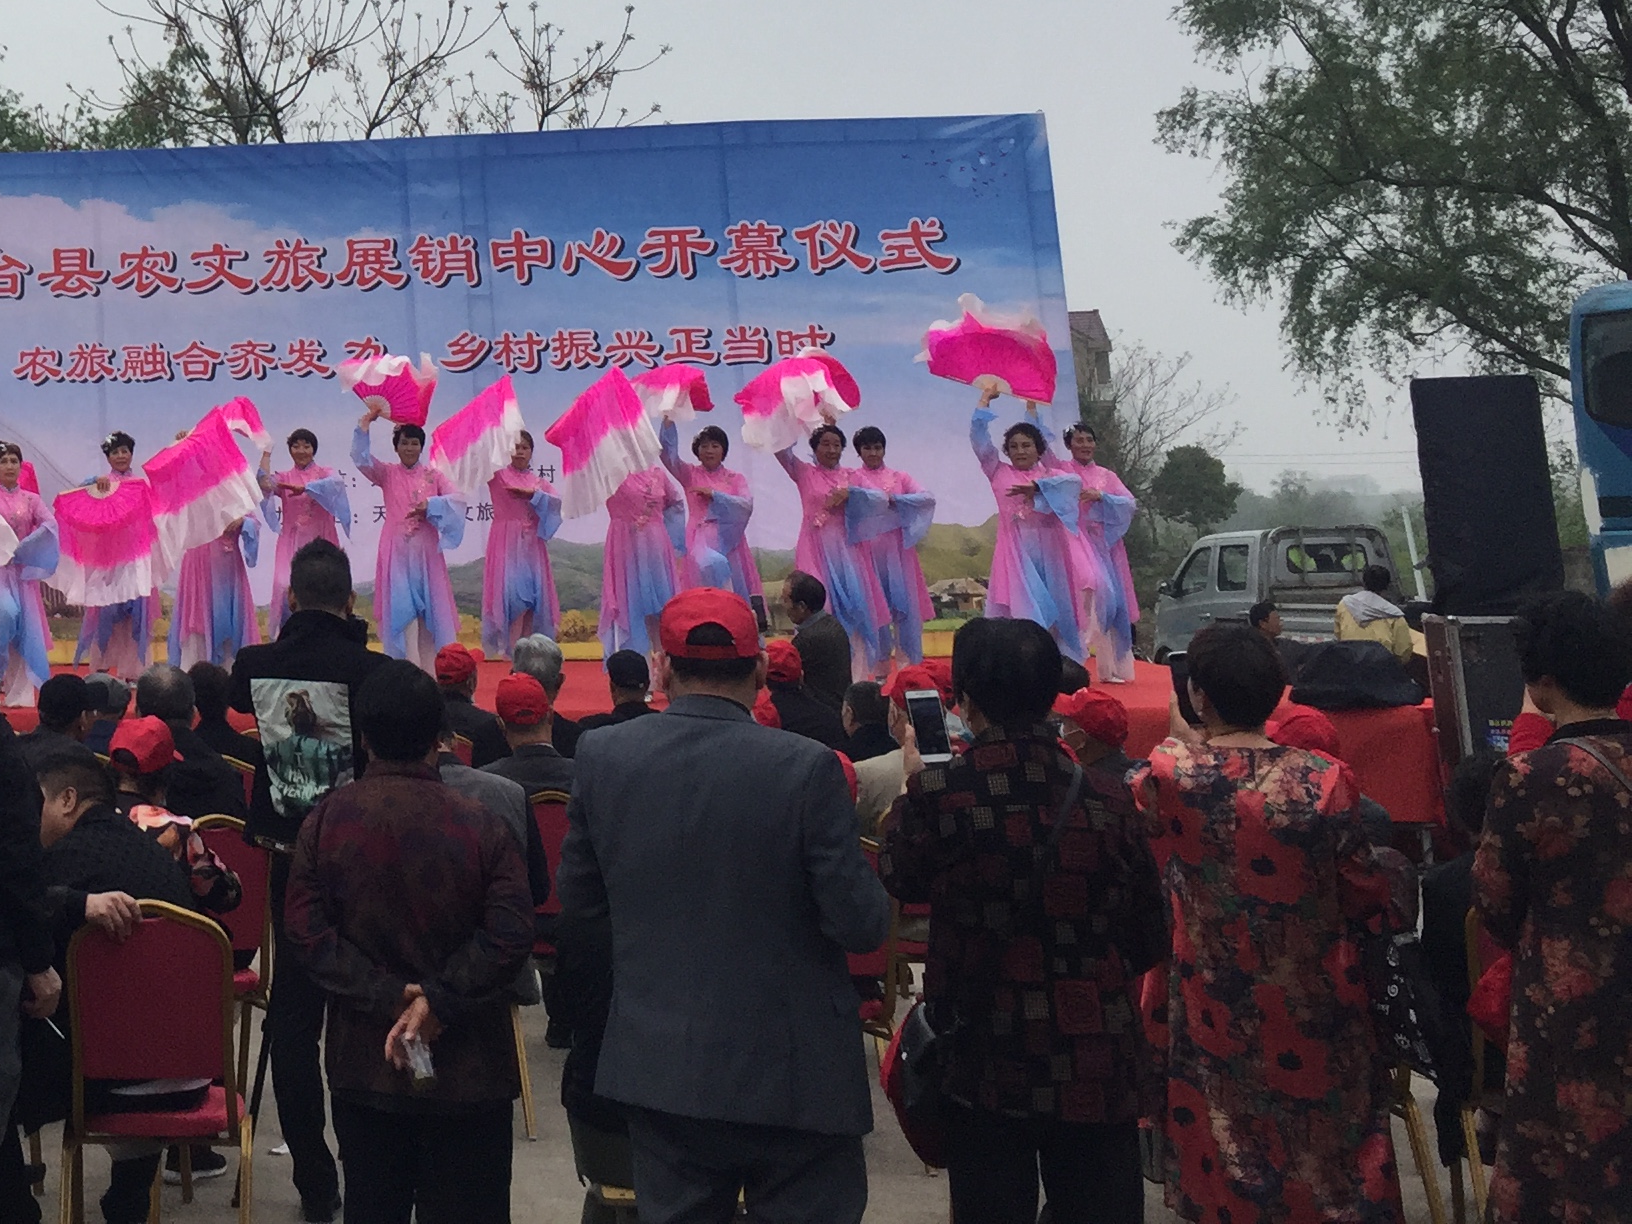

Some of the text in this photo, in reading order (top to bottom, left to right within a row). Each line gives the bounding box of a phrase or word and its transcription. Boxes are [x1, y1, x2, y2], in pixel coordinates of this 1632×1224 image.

[440, 325, 836, 374] 乡村振兴正当时
